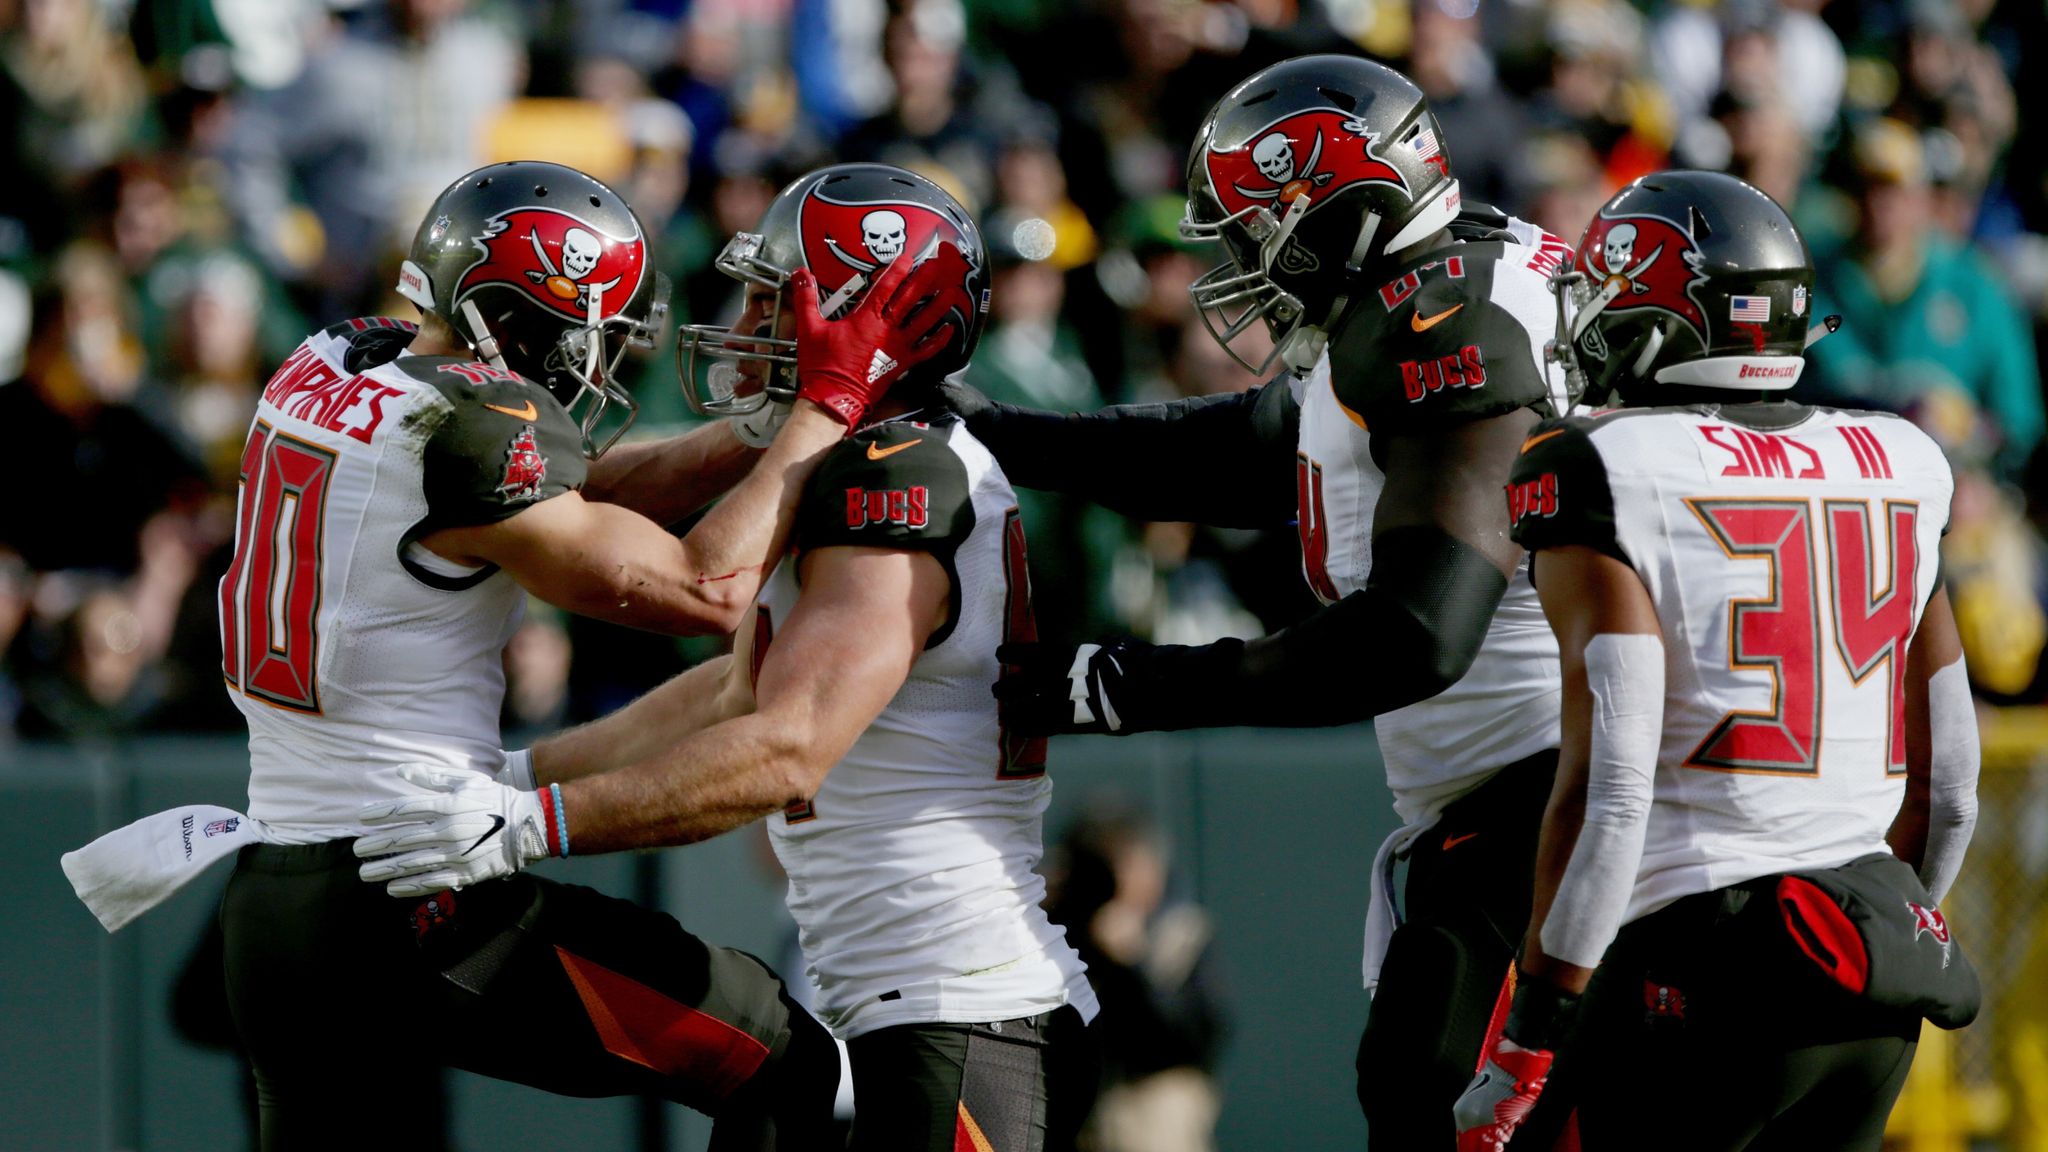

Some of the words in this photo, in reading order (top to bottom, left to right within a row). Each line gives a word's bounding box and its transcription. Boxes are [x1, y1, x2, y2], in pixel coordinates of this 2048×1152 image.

[867, 359, 898, 384] adidas
[1400, 345, 1487, 403] BUCS
[1696, 426, 1825, 480] SIMS
[1835, 426, 1893, 480] III
[846, 486, 928, 530] BUCS
[221, 417, 340, 716] 10
[1682, 497, 1920, 778] 34
[182, 814, 194, 860] Wilson
